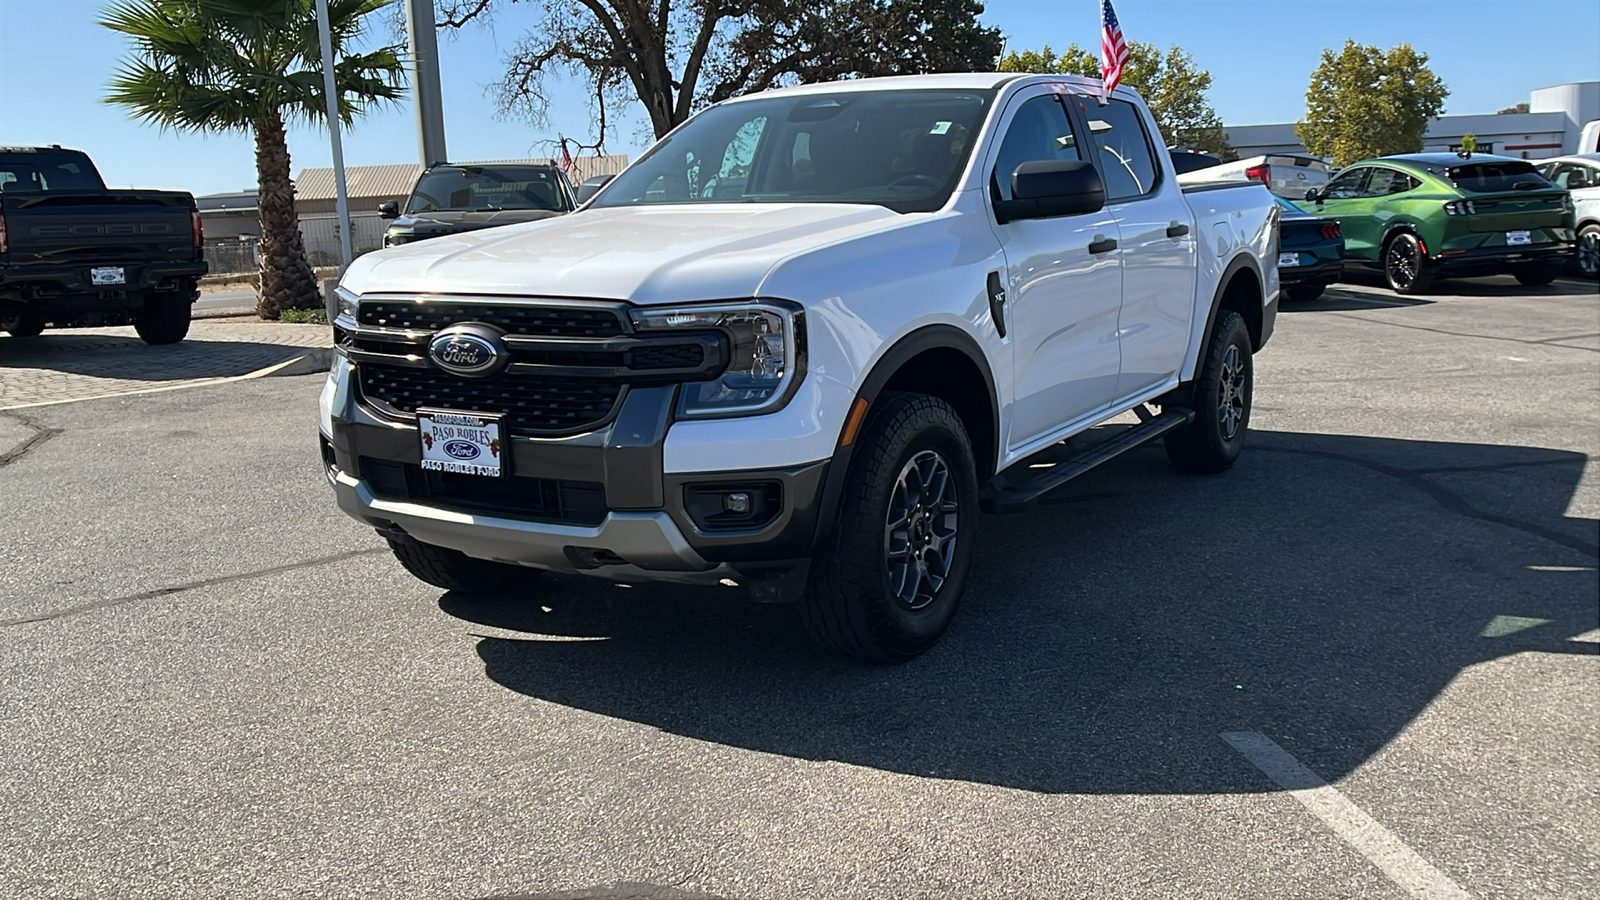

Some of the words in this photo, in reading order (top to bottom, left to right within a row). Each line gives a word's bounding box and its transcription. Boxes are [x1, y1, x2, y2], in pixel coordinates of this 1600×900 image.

[443, 341, 479, 363] Ford
[432, 426, 454, 442] PASO
[457, 428, 491, 447] ROBLES
[450, 442, 474, 457] Ford
[421, 460, 442, 471] PASO
[443, 463, 475, 475] ROBLES
[477, 466, 500, 477] FORD
